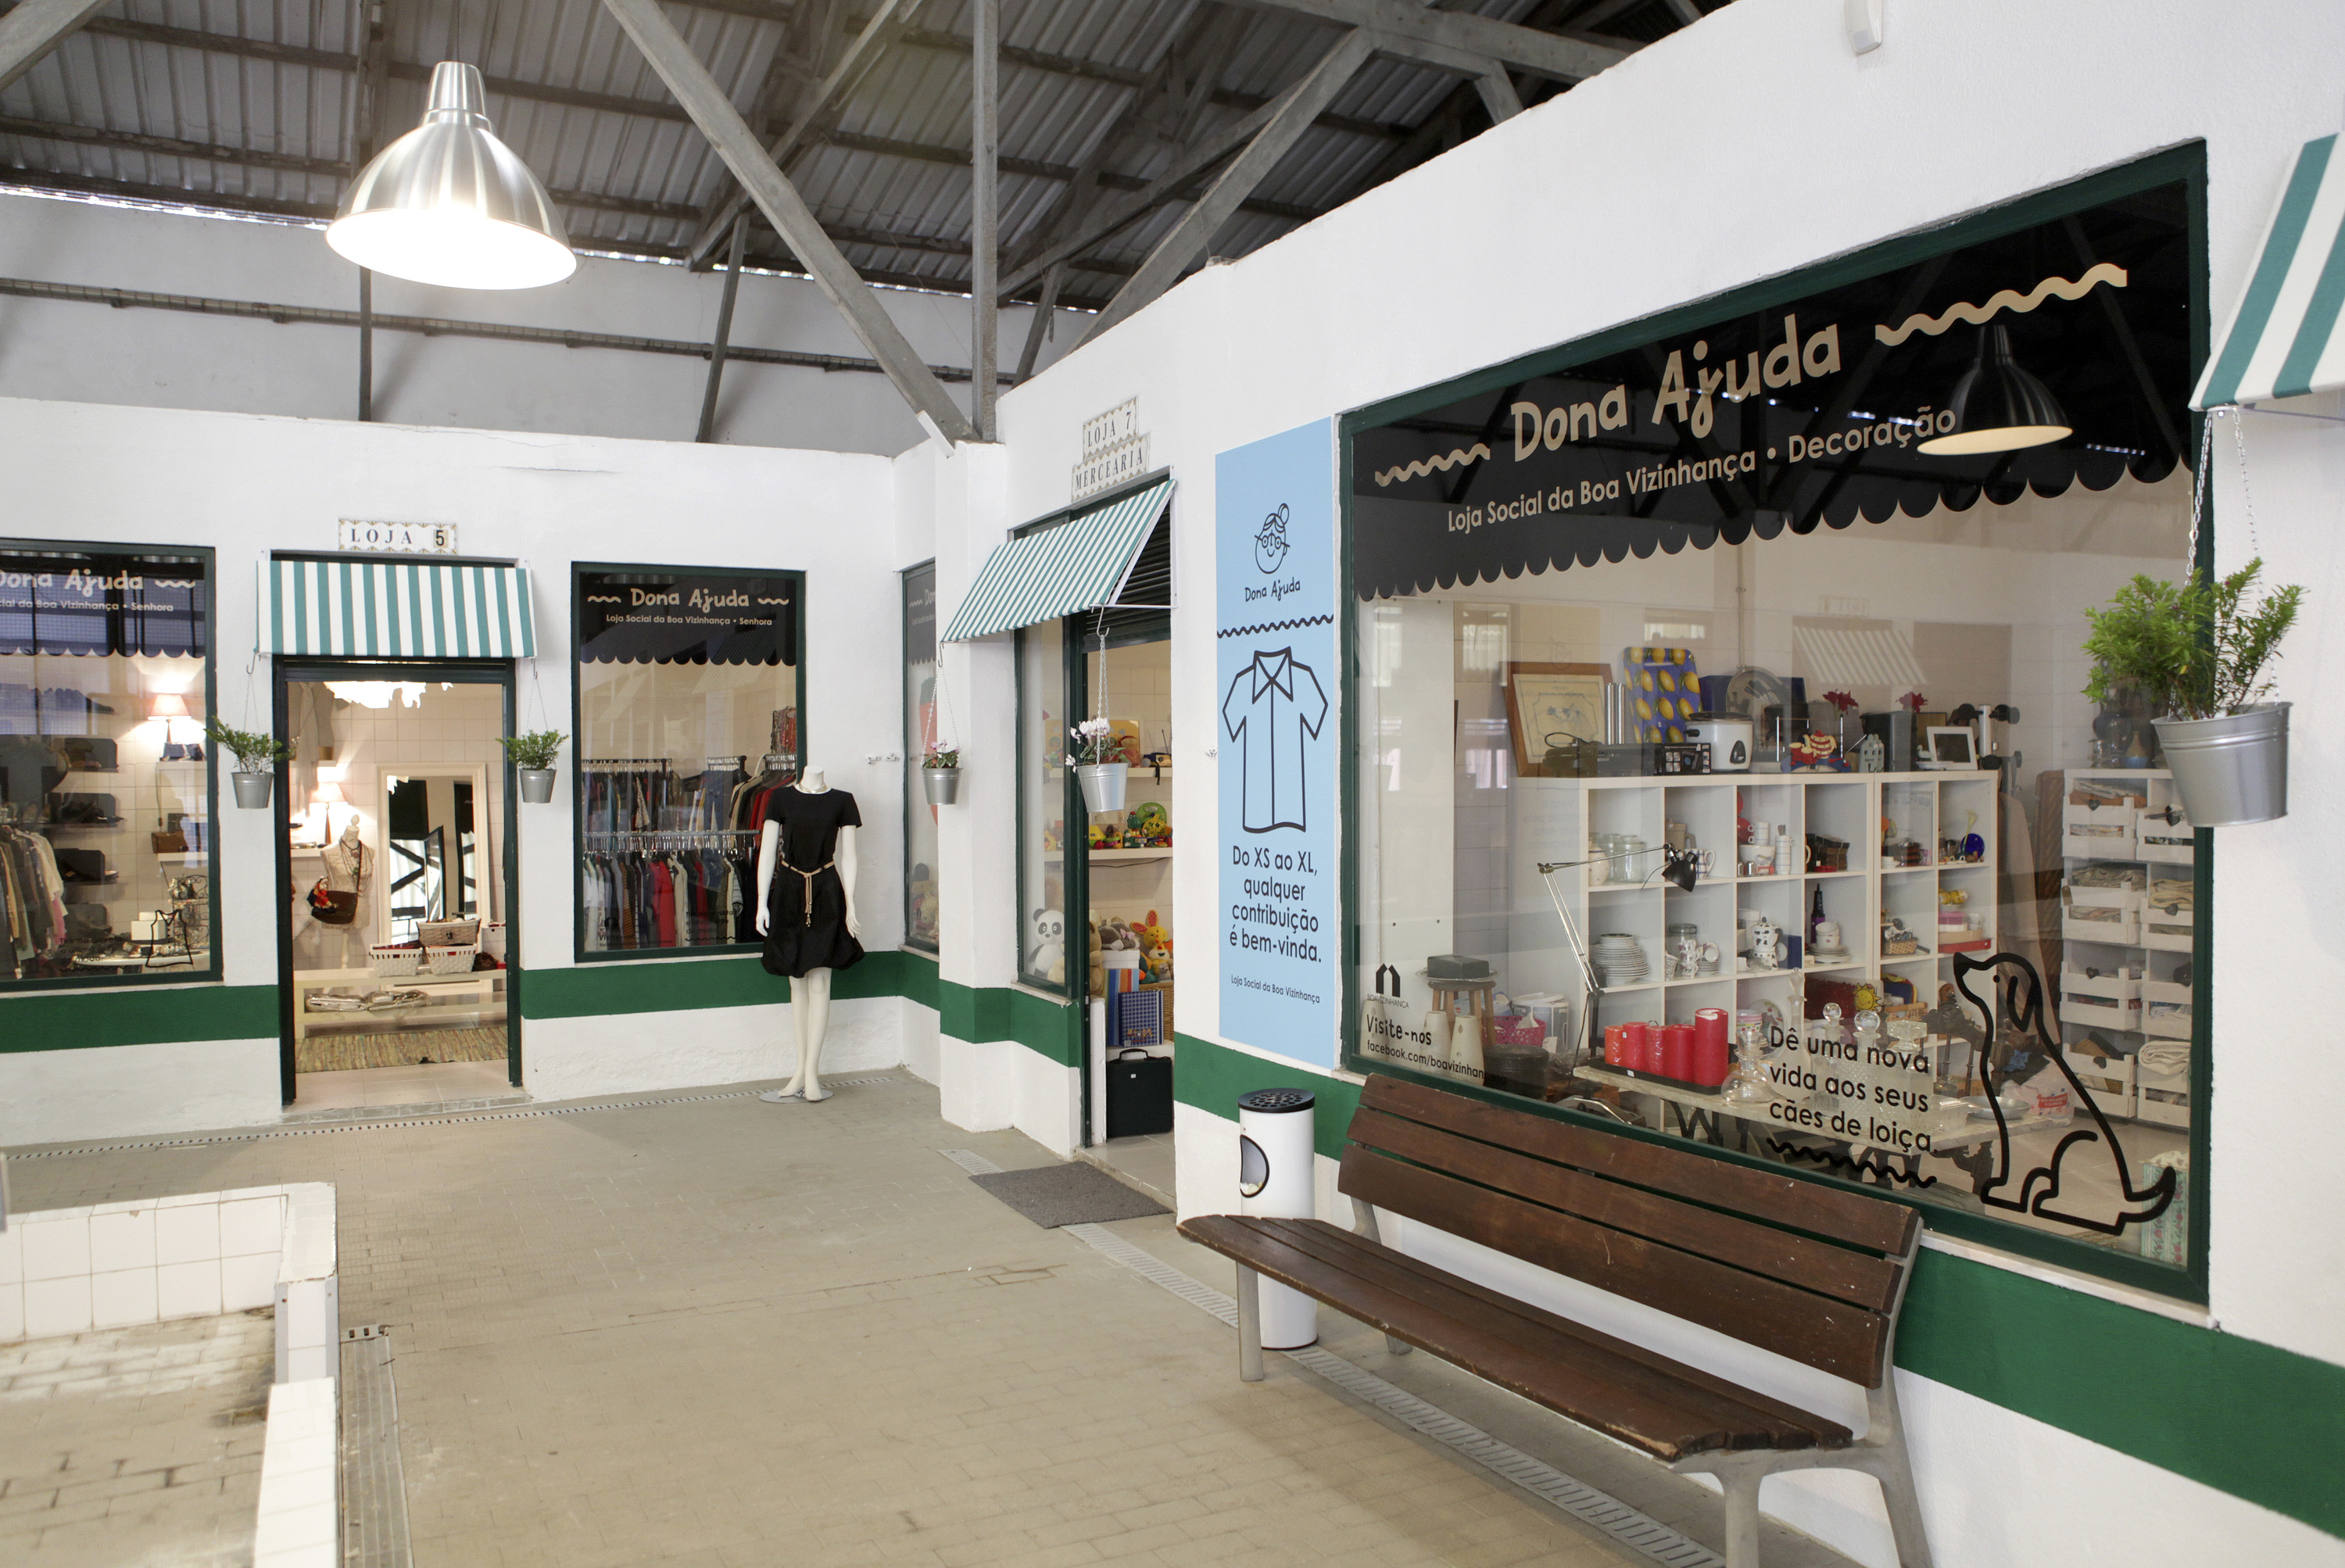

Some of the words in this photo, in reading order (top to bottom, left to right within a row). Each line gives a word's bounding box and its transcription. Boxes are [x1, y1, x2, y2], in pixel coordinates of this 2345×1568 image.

[1511, 384, 1627, 463] Dona
[1651, 313, 1841, 438] Ajuda
[1088, 419, 1115, 447] LOJA
[1126, 411, 1131, 429] 7
[1075, 446, 1142, 491] MERCEARIA
[1448, 503, 1484, 534] Loja
[1488, 491, 1542, 524] Social
[1548, 487, 1574, 515] da
[1581, 479, 1620, 506] Boa
[1626, 448, 1756, 495] Vizinhança
[1788, 406, 1957, 464] Decoração
[351, 528, 412, 544] LOJA
[435, 530, 444, 546] 5
[64, 569, 144, 597] Ajuda
[1245, 587, 1266, 602] Dona
[1271, 577, 1301, 601] Ajuda
[36, 600, 57, 608] Boa
[60, 600, 119, 610] Vizinhança
[131, 603, 174, 611] Senhora
[631, 588, 680, 606] Dona
[689, 589, 749, 613] Ajuda
[607, 614, 624, 623] Loja
[686, 616, 730, 625] Vizinhança
[1233, 845, 1250, 866] Do
[1255, 847, 1269, 868] XS
[1275, 854, 1292, 871] ao
[1298, 850, 1318, 876] XL,
[1244, 876, 1305, 903] qualquer
[1233, 903, 1319, 934] contribuição
[1230, 925, 1237, 946] é
[1242, 928, 1322, 962] bem-vinda.
[1231, 975, 1243, 986] Loja
[1244, 976, 1261, 990] Social
[1262, 983, 1270, 992] da
[1273, 984, 1283, 995] Boa
[1286, 986, 1320, 1004] Vizinhança
[1367, 1015, 1432, 1045] Visite-nos
[1770, 1026, 1799, 1051] Dê
[1807, 1038, 1858, 1061] uma
[1867, 1046, 1929, 1073] nova
[1770, 1064, 1817, 1091] vida
[1825, 1076, 1866, 1101] aos
[1874, 1084, 1929, 1112] seus
[1769, 1099, 1823, 1129] cães
[1831, 1110, 1861, 1137] de
[1870, 1116, 1939, 1154] loiça.
